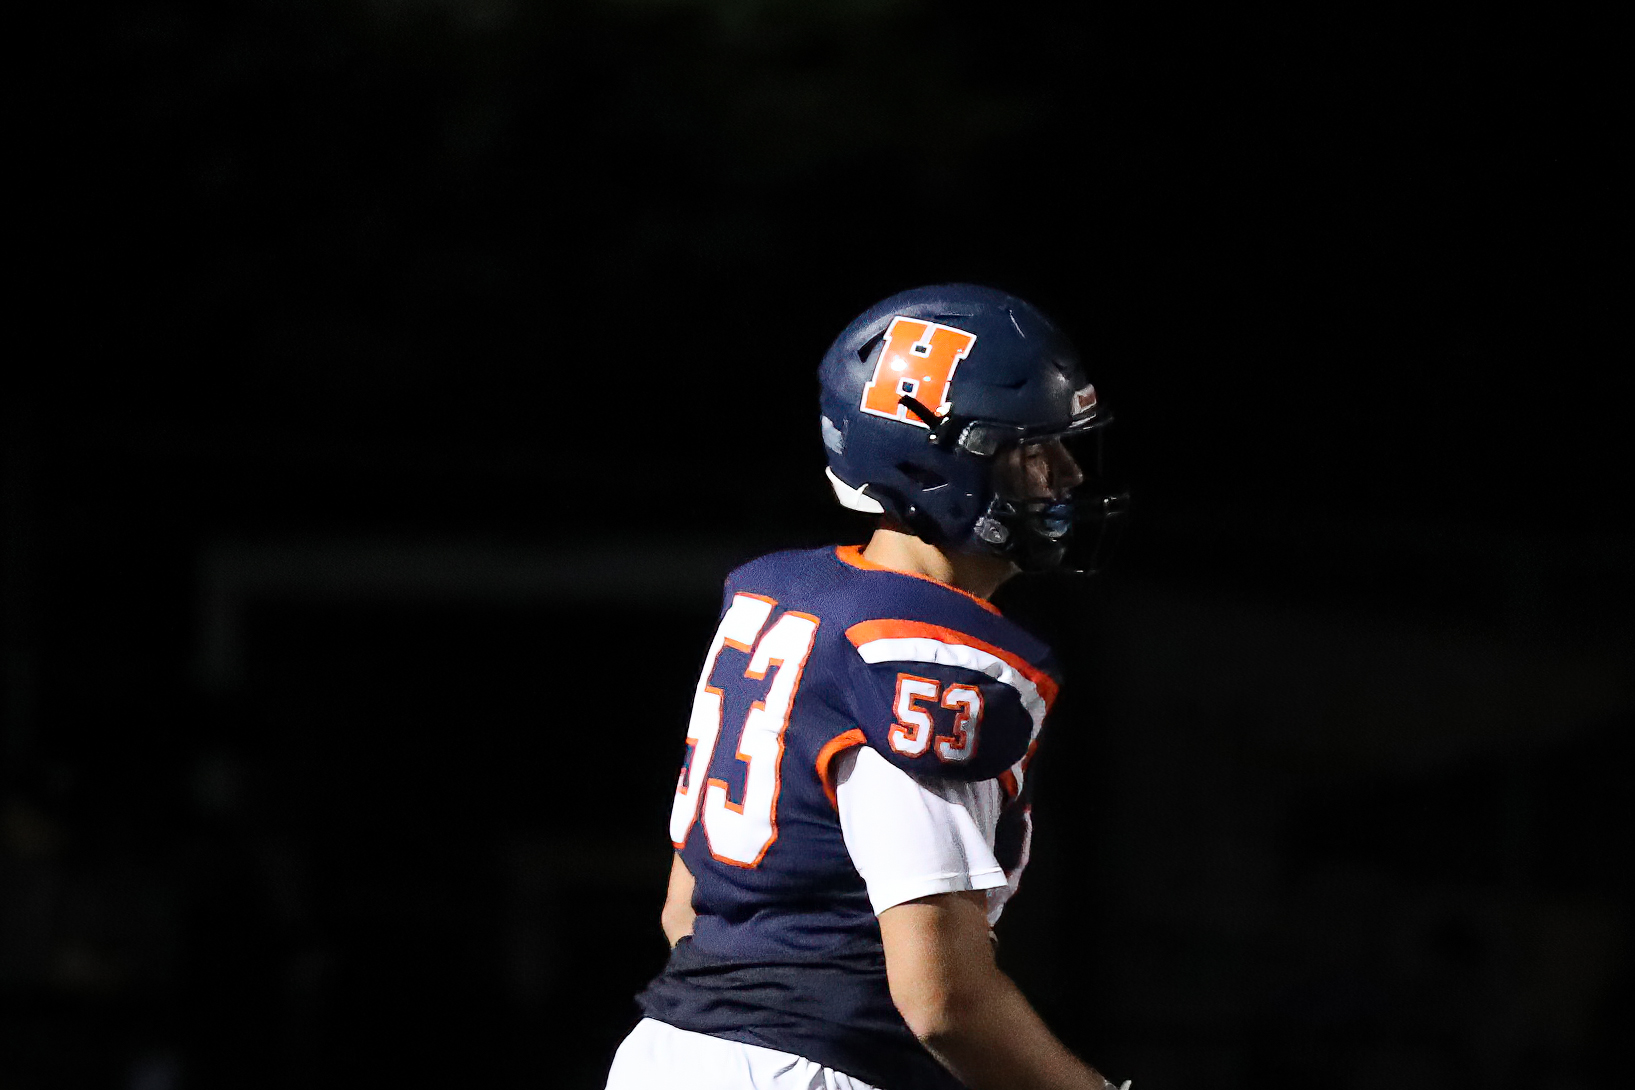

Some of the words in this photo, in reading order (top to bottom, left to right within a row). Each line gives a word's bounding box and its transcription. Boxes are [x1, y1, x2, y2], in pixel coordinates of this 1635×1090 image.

[860, 315, 977, 430] H
[669, 592, 821, 869] 53
[888, 672, 984, 762] 53
